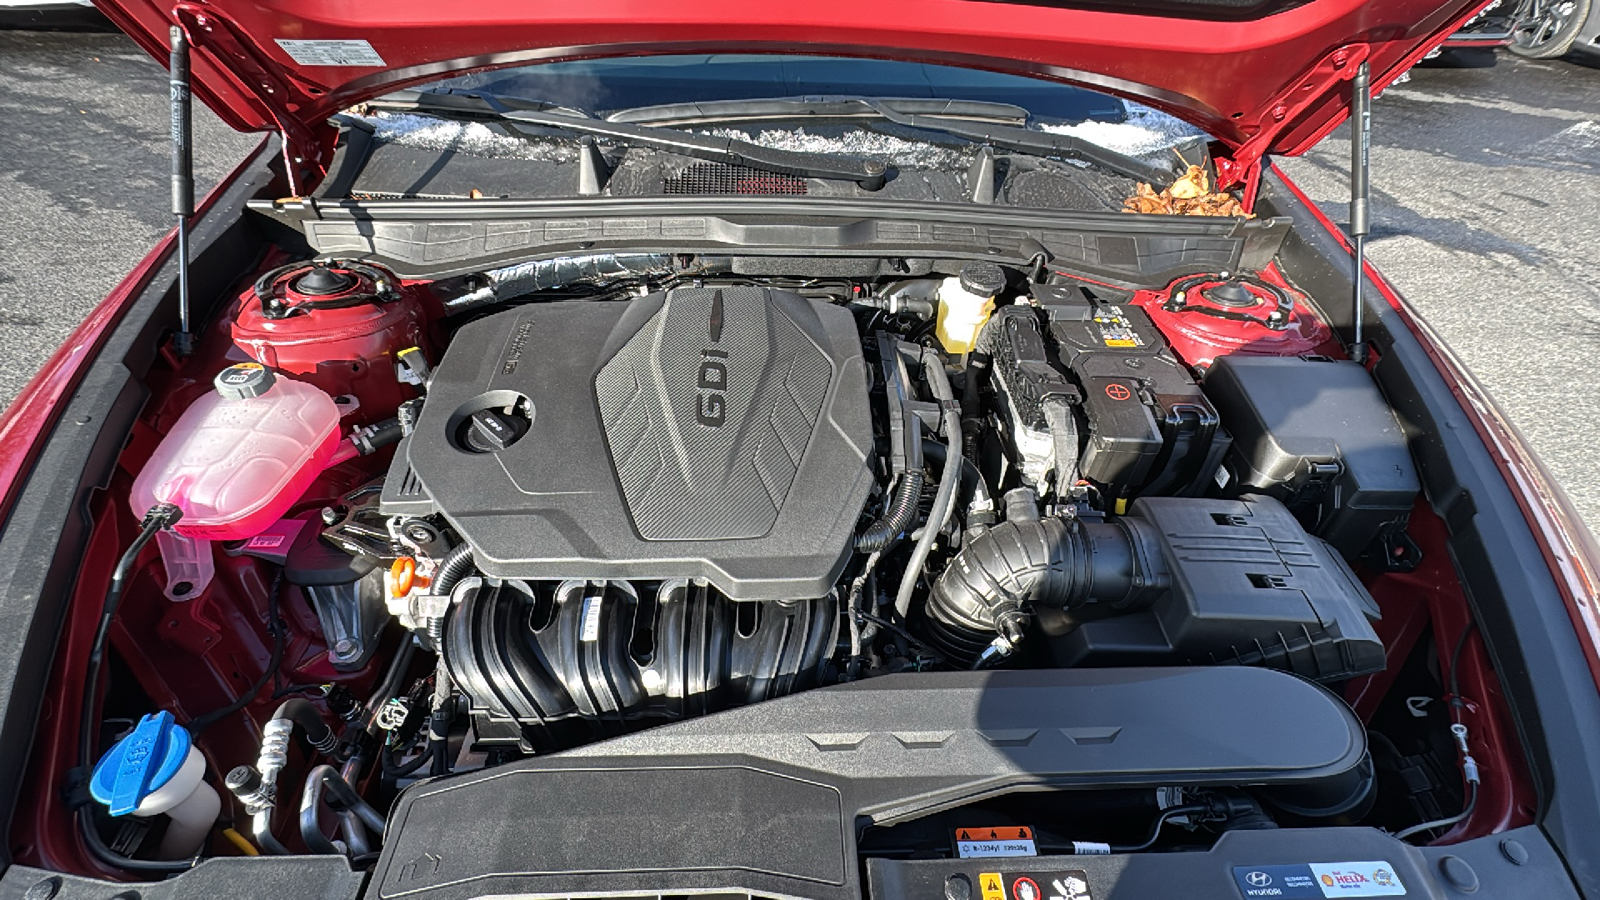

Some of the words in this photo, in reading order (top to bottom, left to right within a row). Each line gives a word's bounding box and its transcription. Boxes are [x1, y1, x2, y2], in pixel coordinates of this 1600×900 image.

[696, 350, 729, 428] GDi
[1335, 874, 1369, 884] HELIX
[1246, 888, 1283, 896] HYUNDAI
